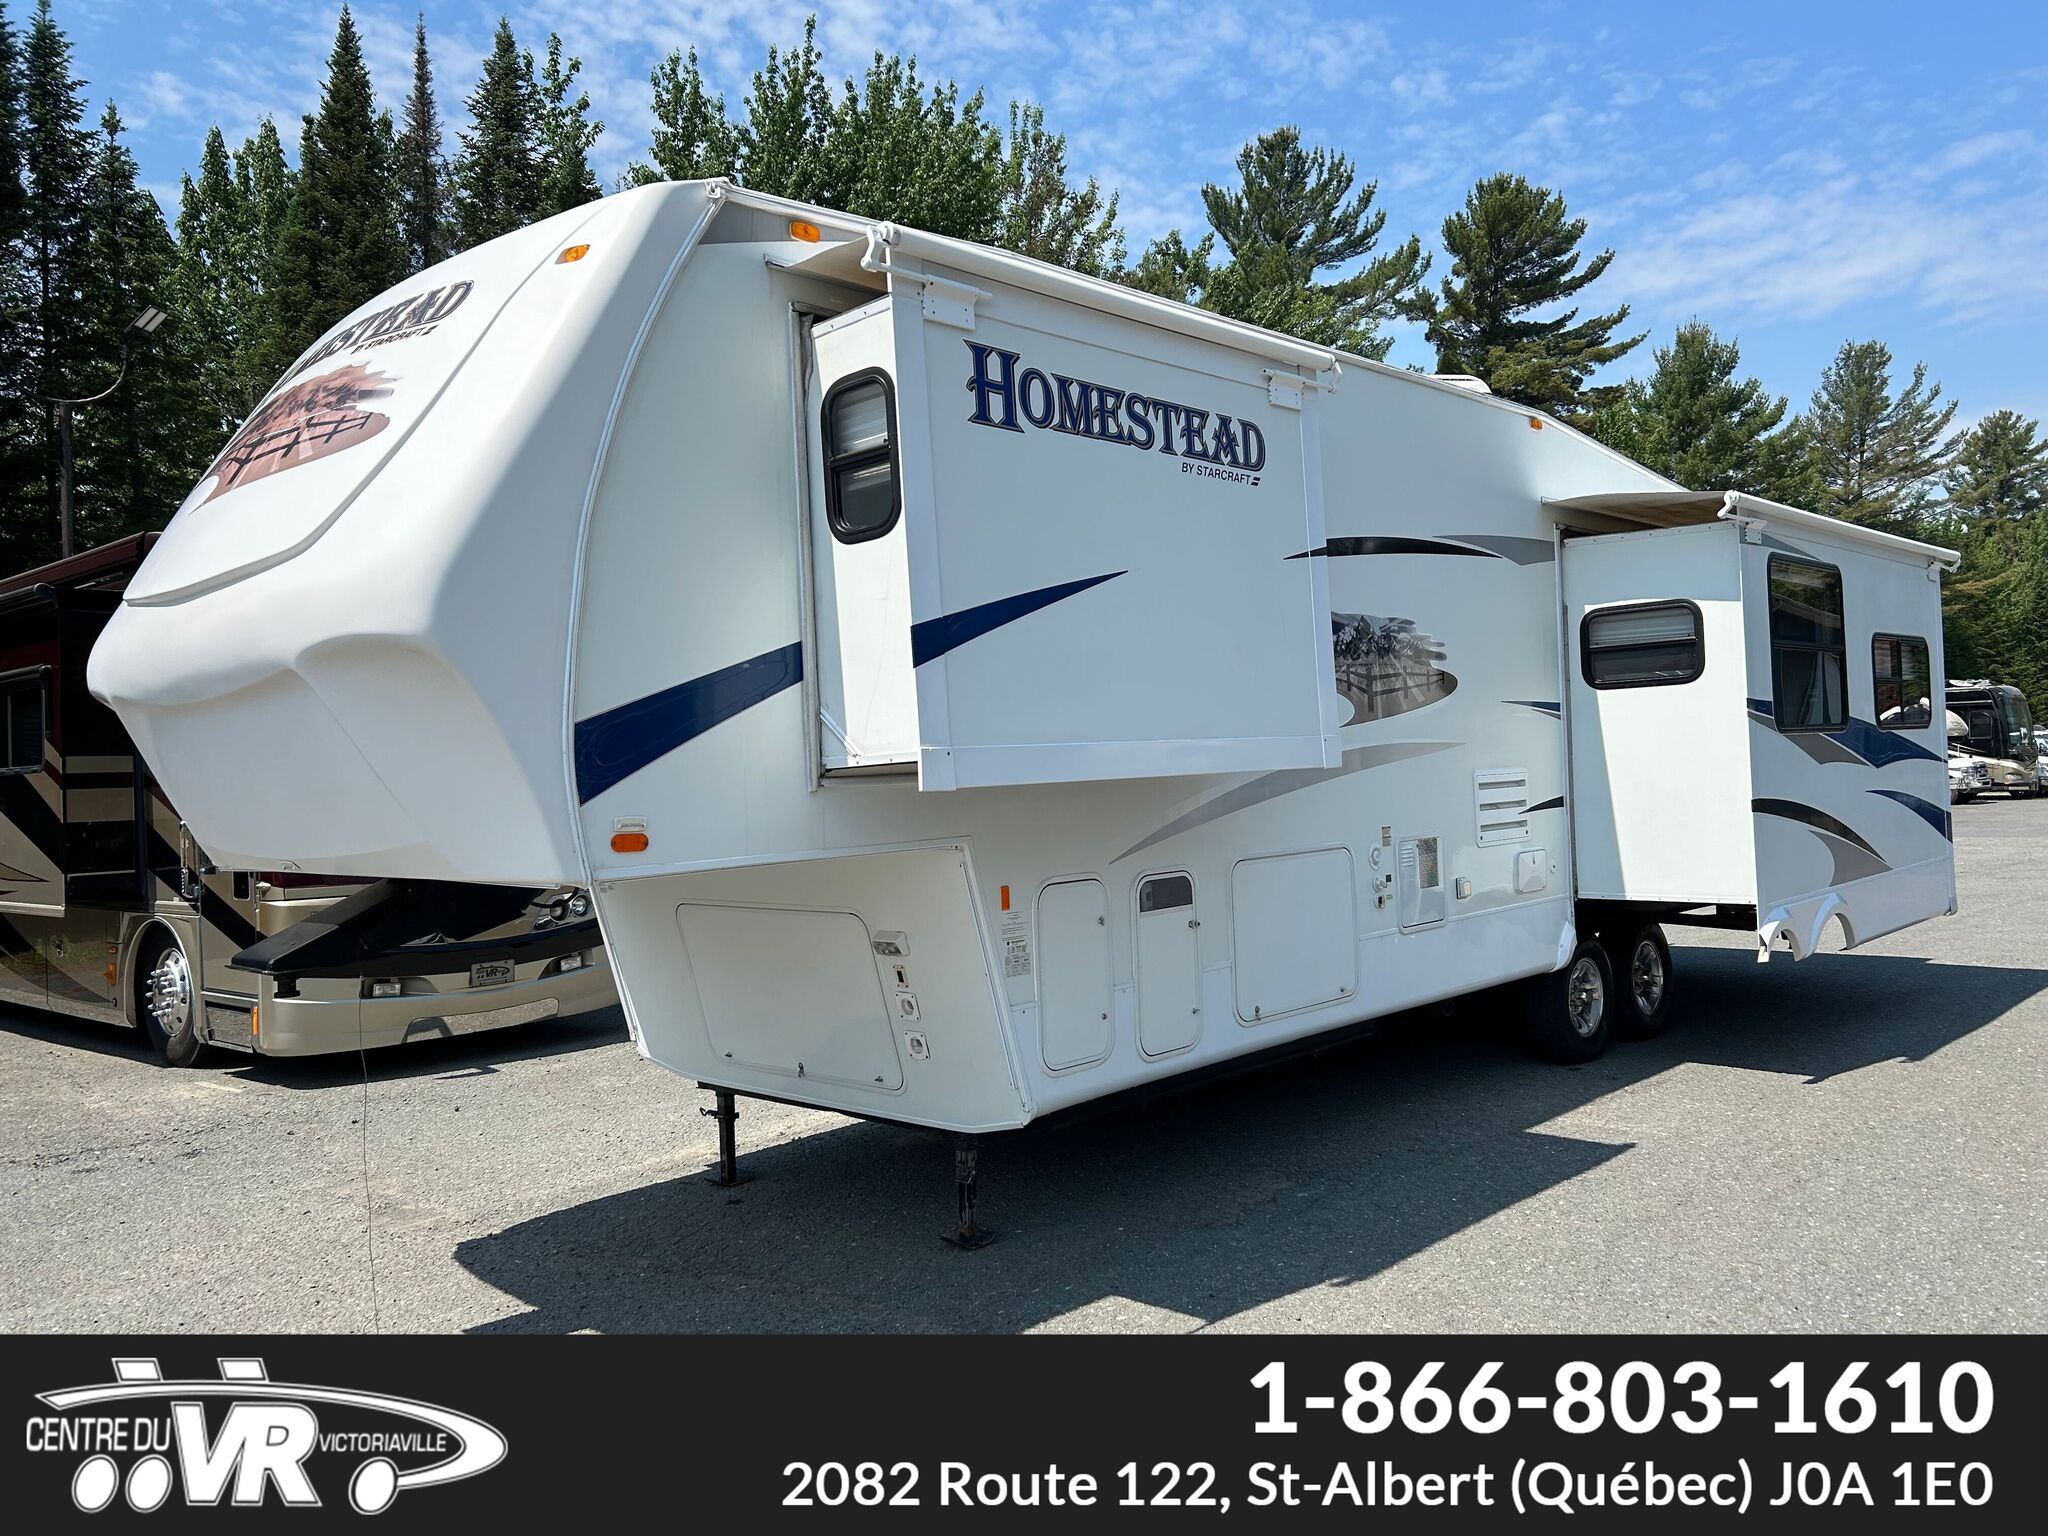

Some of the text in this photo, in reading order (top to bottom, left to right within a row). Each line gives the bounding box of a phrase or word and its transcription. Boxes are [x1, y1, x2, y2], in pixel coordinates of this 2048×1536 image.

[364, 326, 428, 351] STARCRAFT
[963, 338, 1267, 472] HOMESTEAD
[1181, 461, 1252, 486] BY STARCRAFT
[485, 967, 498, 978] VR
